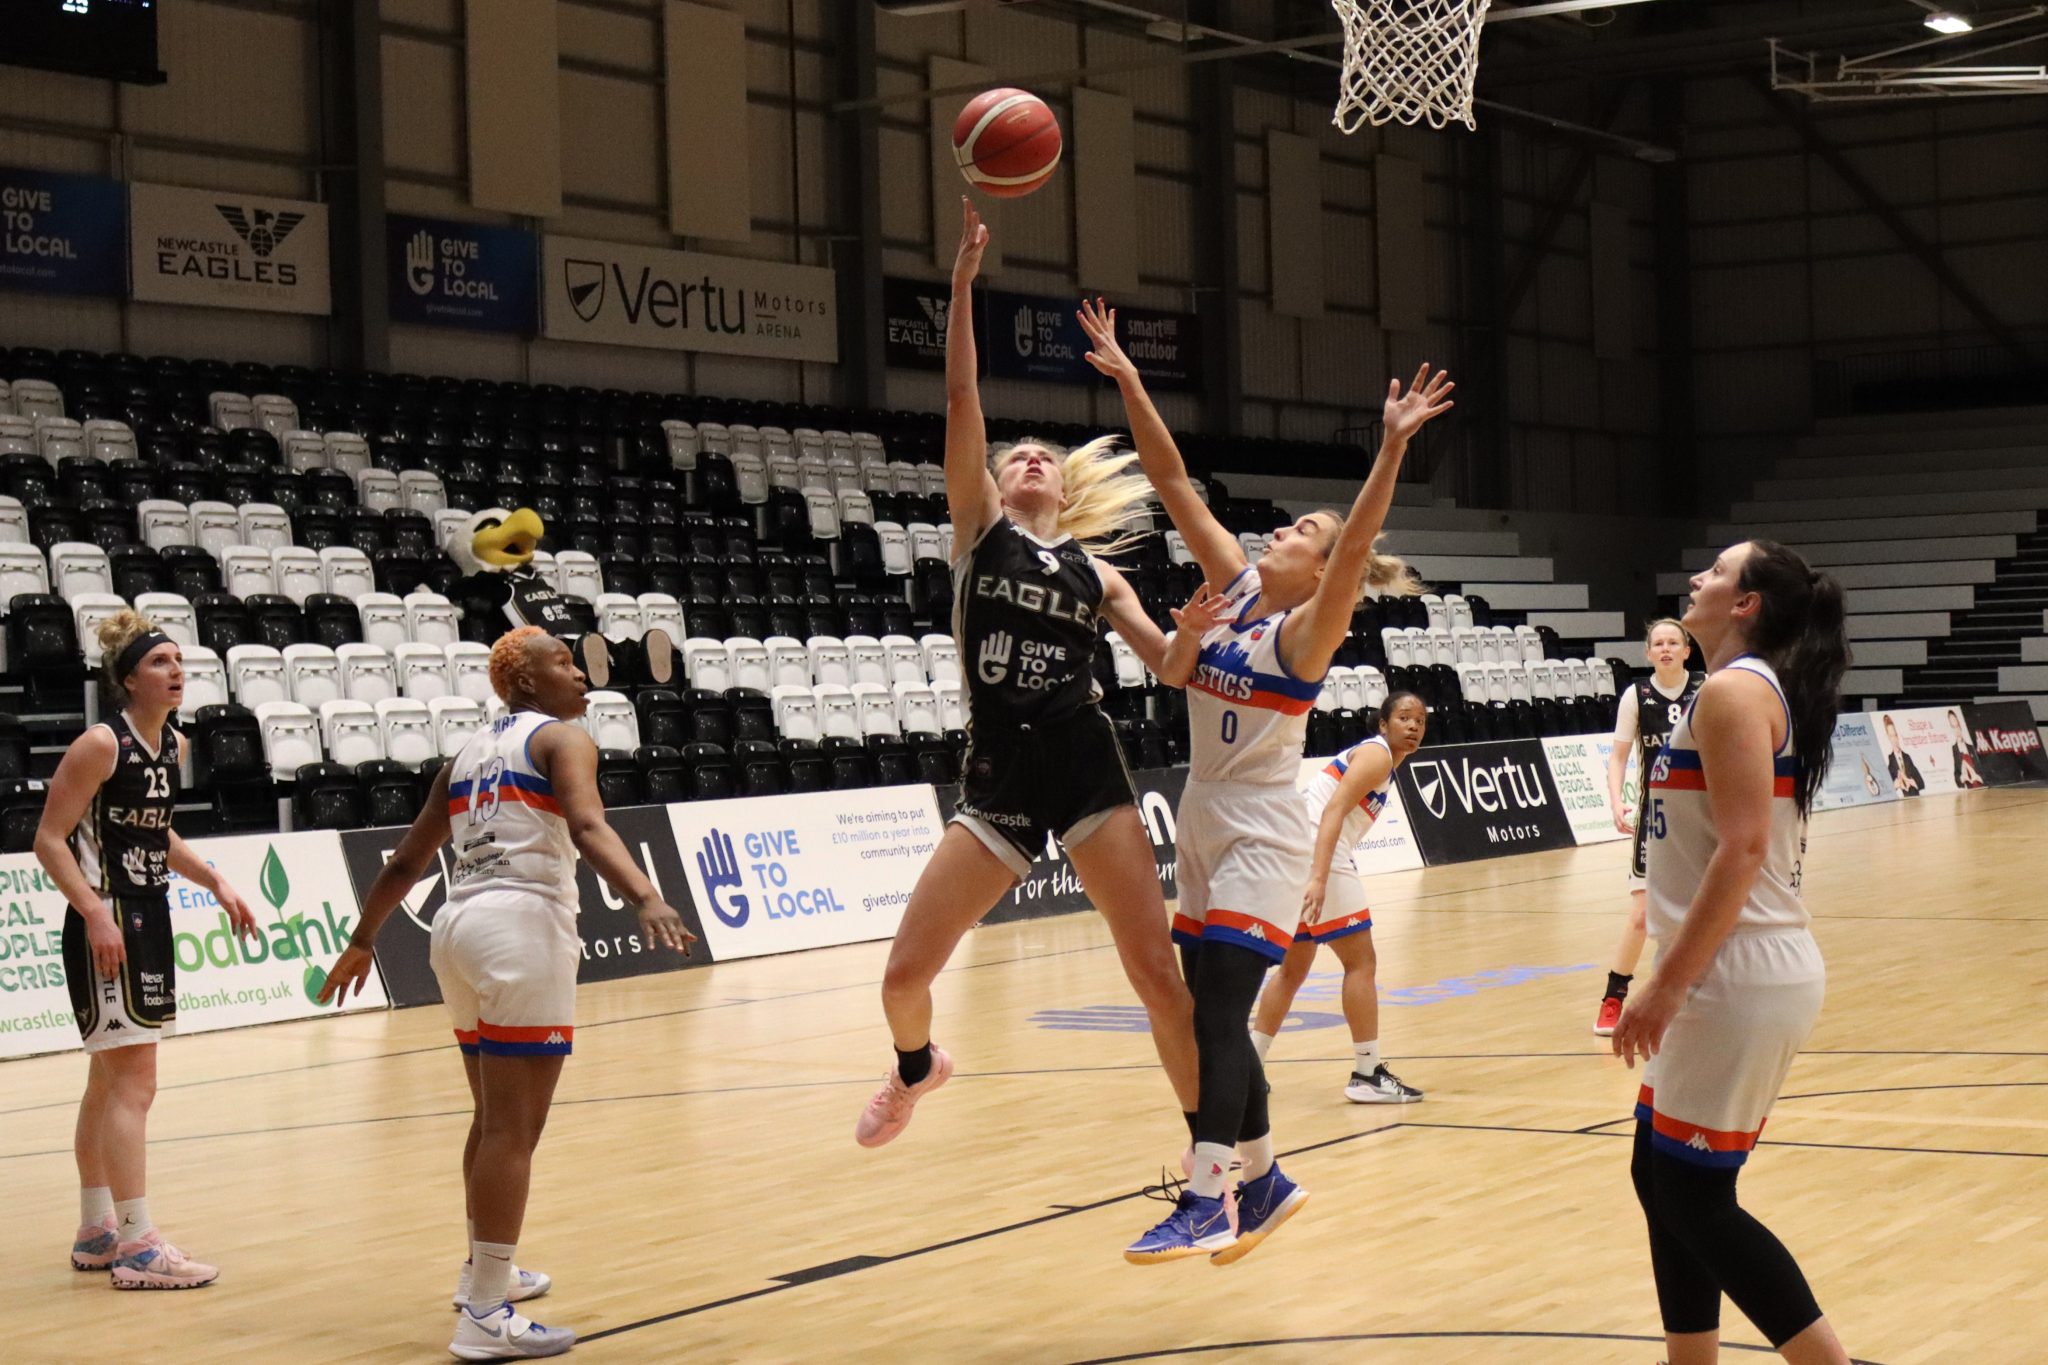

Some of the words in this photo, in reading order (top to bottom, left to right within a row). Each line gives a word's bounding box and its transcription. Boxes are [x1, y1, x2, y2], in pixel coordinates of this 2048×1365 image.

[2, 187, 51, 212] GIVE
[3, 210, 34, 231] TO
[6, 233, 77, 259] LOCAL
[157, 237, 240, 256] NEWCASTLE
[440, 238, 479, 260] GIVE
[157, 252, 297, 286] EAGLES
[442, 258, 465, 277] TO
[444, 277, 499, 301] LOCAL
[612, 263, 746, 334] Vertu
[754, 291, 827, 315] Motors
[1036, 311, 1062, 327] GIVE
[1127, 319, 1163, 338] smart
[756, 323, 801, 339] ARENA
[1037, 326, 1053, 341] TO
[1039, 343, 1075, 360] LOCAL
[1128, 338, 1178, 360] outdoor
[1037, 550, 1060, 576] 9
[1020, 640, 1067, 661] GIVE
[1019, 655, 1047, 673] TO
[1668, 704, 1682, 724] 8
[1221, 710, 1238, 745] 0
[1988, 728, 2039, 752] Kappa
[1548, 743, 1587, 760] HELPING
[1553, 761, 1585, 776] LOCAL
[144, 767, 170, 798] 23
[465, 757, 504, 826] 13
[1441, 756, 1547, 814] Vertu
[1558, 778, 1594, 793] PEOPLE
[836, 813, 864, 825] We're
[866, 810, 897, 823] aiming
[899, 810, 908, 819] to
[910, 808, 925, 821] put
[961, 802, 1032, 827] Newcastle
[744, 829, 800, 858] GIVE
[832, 832, 848, 844] £10
[850, 830, 880, 842] million
[882, 831, 889, 839] a
[891, 828, 911, 841] year
[912, 826, 930, 836] into
[1486, 824, 1540, 843] Motors
[860, 845, 910, 859] community
[912, 843, 934, 855] sport
[752, 862, 787, 888] TO
[1050, 864, 1084, 897] the
[762, 887, 845, 919] LOCAL
[174, 981, 293, 1012] dbank.org.uk
